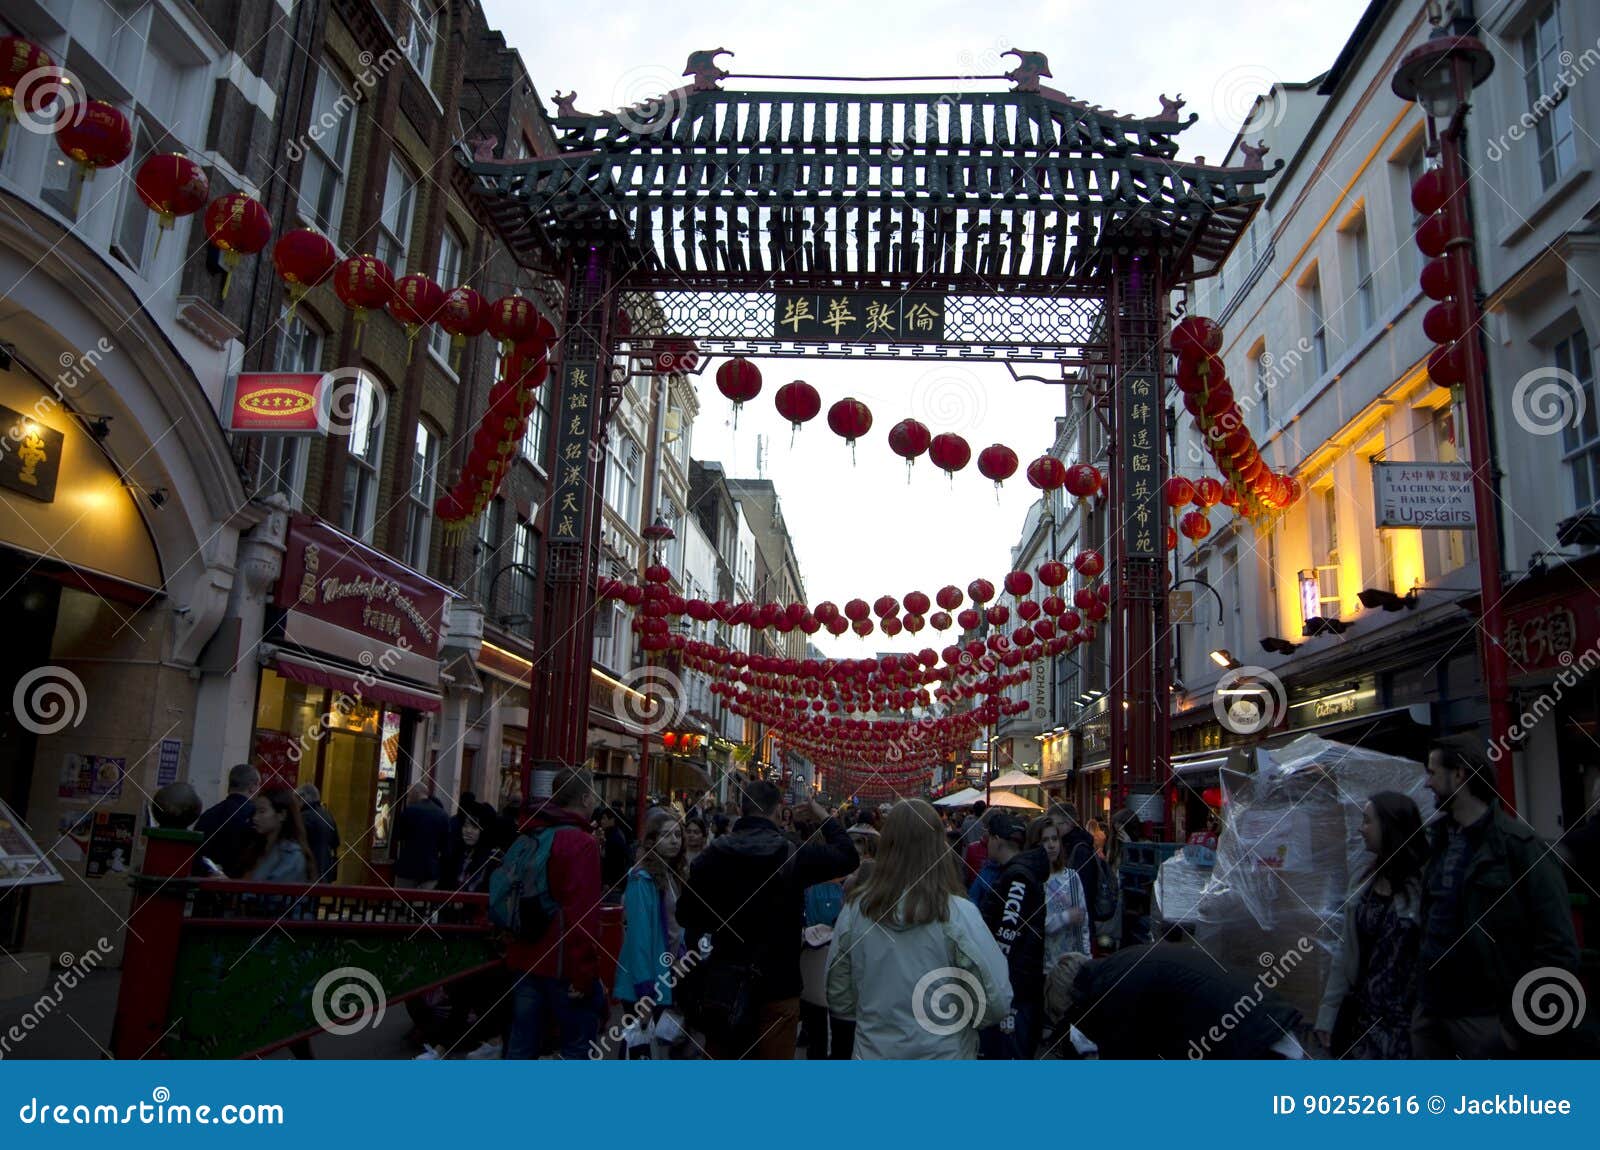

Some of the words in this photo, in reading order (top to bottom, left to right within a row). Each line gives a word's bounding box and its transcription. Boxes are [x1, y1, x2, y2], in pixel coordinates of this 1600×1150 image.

[1391, 484, 1406, 493] TAI
[1410, 484, 1445, 493] CHUNG
[1400, 495, 1427, 504] HAIR
[1430, 495, 1463, 504] SALON
[1400, 507, 1472, 525] Upstairs
[1036, 657, 1045, 705] AOZHAN
[1002, 881, 1026, 925] KICK
